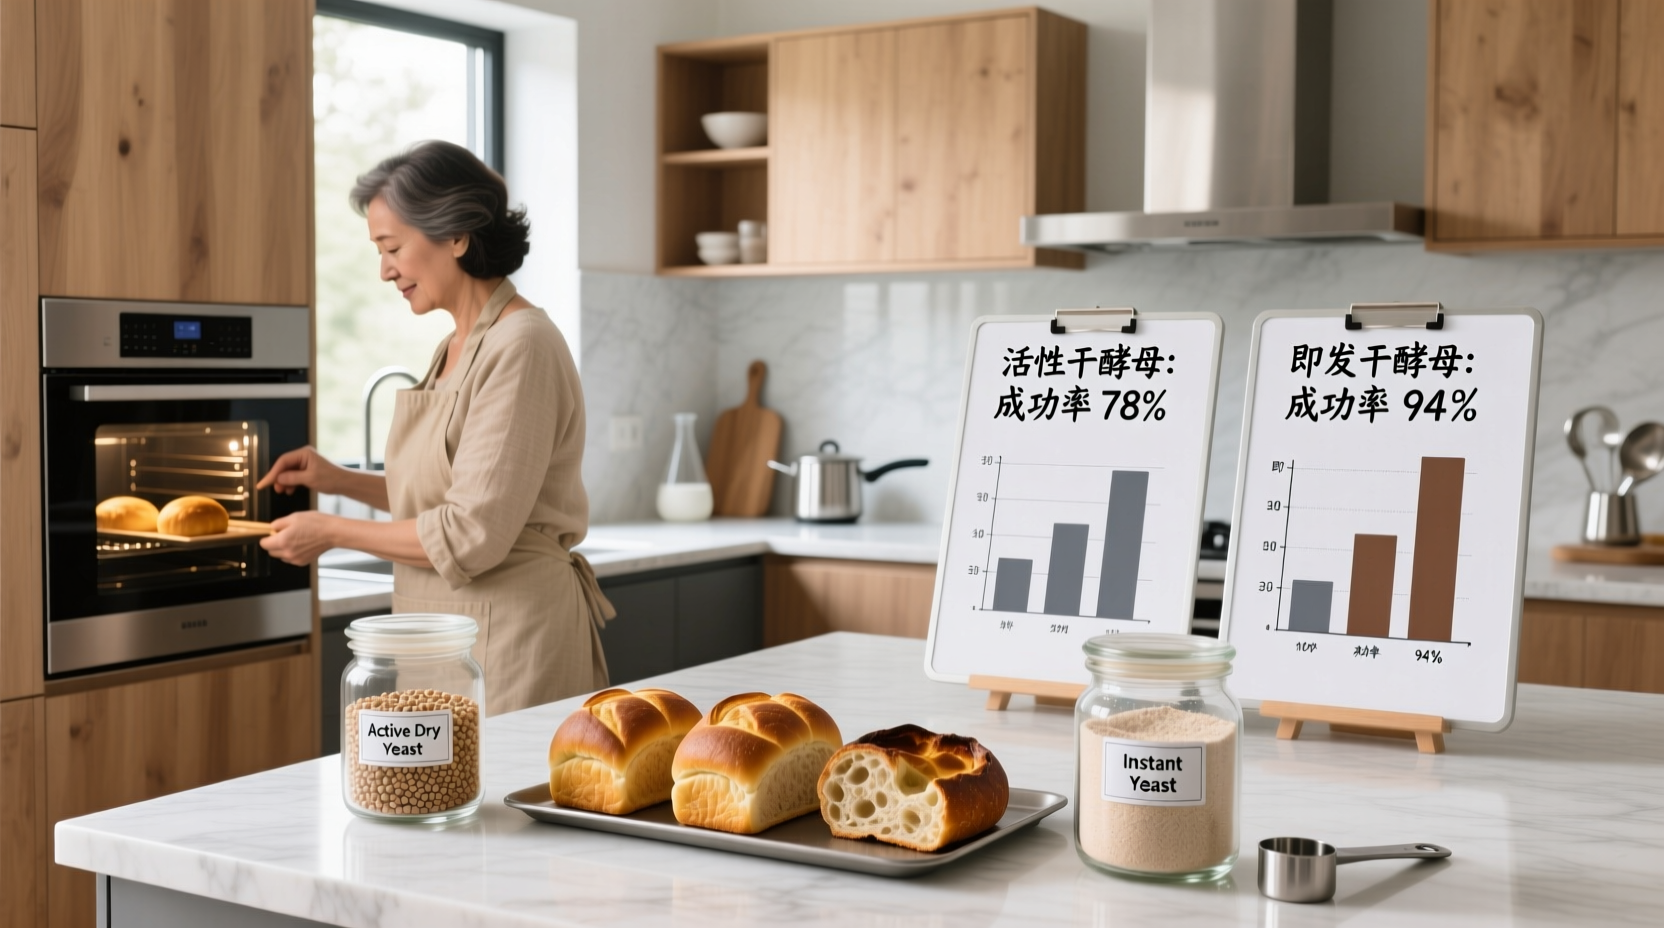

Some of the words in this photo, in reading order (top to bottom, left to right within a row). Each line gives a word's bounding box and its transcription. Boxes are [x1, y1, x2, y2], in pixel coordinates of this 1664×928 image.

[1002, 343, 1176, 380] 活性干酵母:
[1290, 341, 1475, 379] 即发干酵母:
[993, 385, 1091, 423] 成功率
[1101, 389, 1167, 422] 78%
[1285, 384, 1389, 424] 成功率
[1403, 387, 1478, 422] 94%
[1415, 649, 1443, 664] 94%
[368, 723, 411, 738] Active
[415, 723, 441, 740] Dry
[383, 742, 423, 756] Yeast
[1123, 753, 1183, 771] Instant
[1129, 775, 1177, 793] Yeast
